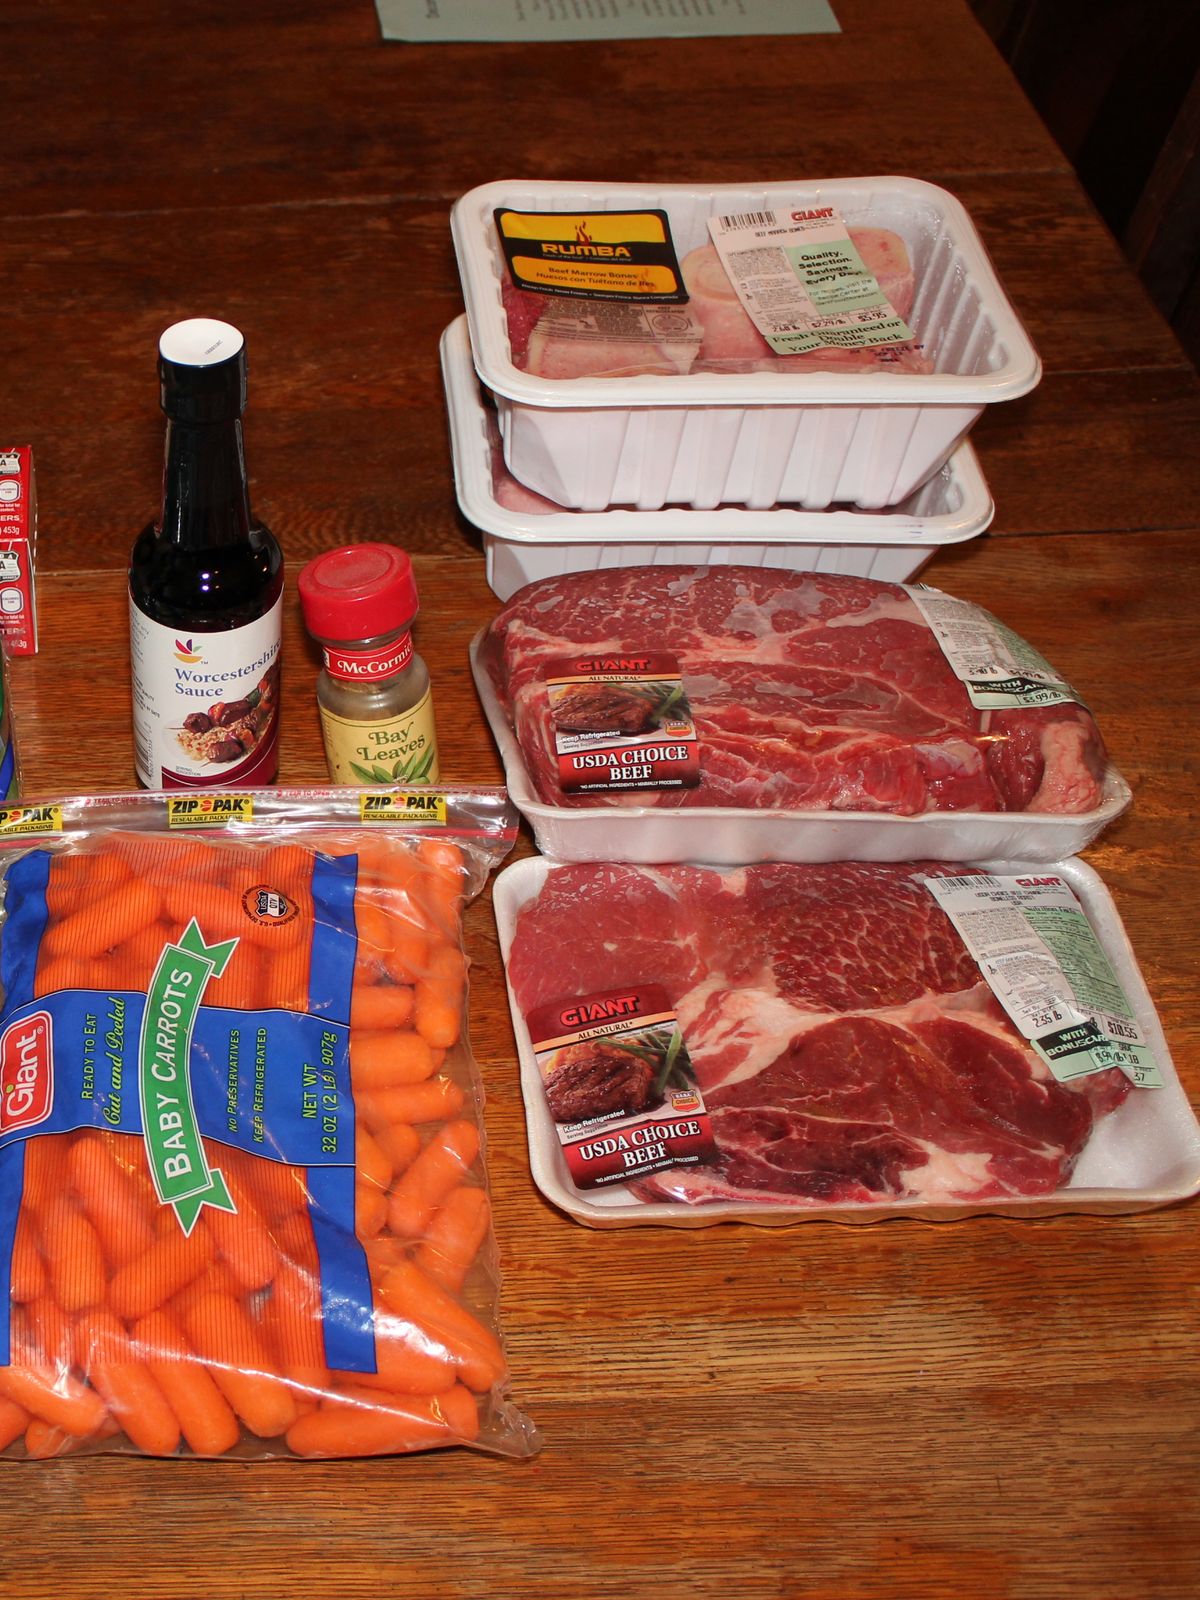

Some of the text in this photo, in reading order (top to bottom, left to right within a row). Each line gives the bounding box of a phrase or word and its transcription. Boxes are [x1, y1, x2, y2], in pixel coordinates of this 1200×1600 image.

[791, 207, 833, 221] GIANT
[540, 243, 631, 257] RUMBA
[801, 251, 844, 261] Quality.
[798, 257, 853, 270] Selection.
[806, 265, 853, 277] Savings.
[536, 272, 568, 280] Huesos
[569, 275, 586, 283] con
[571, 269, 607, 278] Marrow
[805, 274, 836, 286] Every
[772, 320, 901, 343] Fresh Guaranteed or
[819, 334, 864, 342] Double
[788, 333, 904, 352] Your Money Back
[2, 526, 20, 535] 453g
[575, 659, 650, 672] GIANT
[175, 683, 224, 697] Sauce
[368, 721, 414, 746] Bay
[580, 730, 621, 741] Refrigerated
[356, 733, 426, 762] Leaves
[572, 746, 688, 769] USDA CHOICE
[609, 764, 653, 781] BEEF
[172, 799, 245, 814] ZIP PAK
[364, 796, 439, 810] ZIP PAK
[22, 807, 54, 823] PAK
[170, 815, 208, 823] RESEALABLE
[402, 812, 438, 820] PACKAGING
[1015, 877, 1061, 887] GIANT
[560, 995, 639, 1027] GIANT
[104, 997, 126, 1052] Peeled
[577, 1031, 592, 1041] ALL
[1059, 1027, 1087, 1042] WITH
[1045, 1034, 1109, 1057] BONUSCAR
[80, 1013, 97, 1100] READY TO EAT
[5, 1027, 39, 1117] Giant
[110, 1063, 124, 1093] and
[150, 966, 195, 1181] BABY CARROTS
[226, 1029, 240, 1133] NO PRESERVATIVES
[253, 1027, 268, 1143] KEEP REFRIGERATED
[302, 1063, 317, 1119] NET WT
[321, 1031, 340, 1154] 32 OZ (2 LB) 907g
[563, 1109, 626, 1134] Keep Refrigerated
[578, 1120, 701, 1161] USDA CHOICE
[621, 1141, 666, 1168] BEEF
